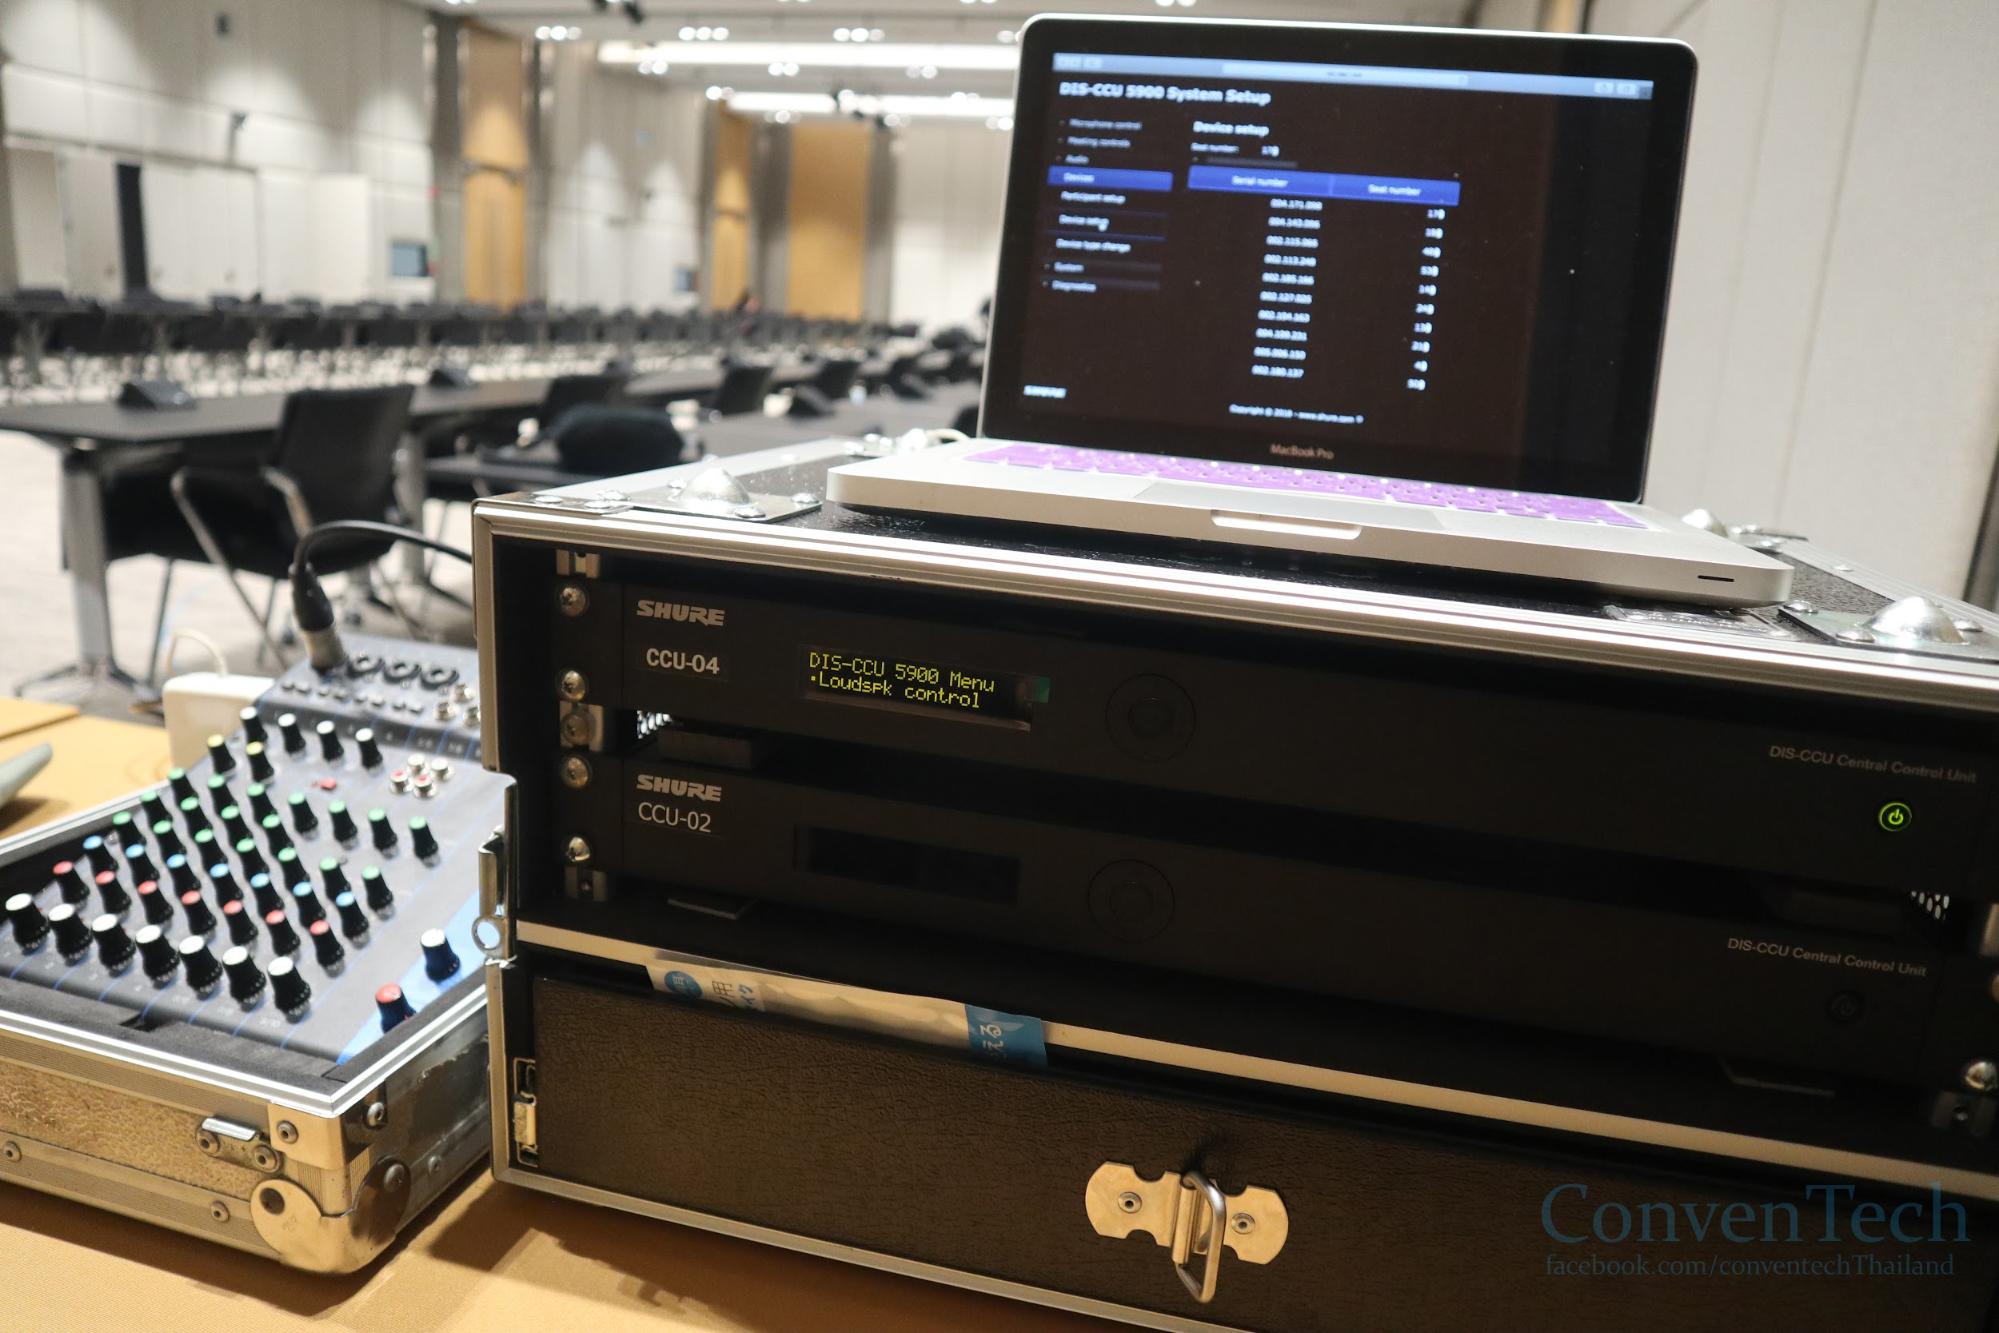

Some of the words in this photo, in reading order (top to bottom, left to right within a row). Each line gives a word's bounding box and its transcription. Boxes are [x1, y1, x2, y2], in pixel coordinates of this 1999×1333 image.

[1059, 81, 1124, 98] DIS-CCU
[1125, 84, 1165, 99] 5900
[1166, 86, 1224, 103] System
[1225, 88, 1271, 106] Setup
[1193, 120, 1233, 135] Device
[1271, 443, 1314, 457] MacBook
[1316, 447, 1335, 460] Pro
[636, 600, 725, 627] SHURE
[646, 647, 720, 675] CCU-04
[809, 651, 886, 677] DIS-CCU
[895, 663, 940, 685] 5900
[949, 671, 995, 692] Menu
[904, 685, 981, 709] control
[1769, 745, 1834, 765] DIS-CCU
[1836, 754, 1888, 773] Central
[1891, 761, 1944, 780] Control
[1947, 768, 1977, 784] Unit
[636, 774, 722, 801] SHURE
[638, 801, 712, 833] CCU-02
[1727, 937, 1790, 957] DIS-CCU
[1792, 947, 1841, 966] Central
[1844, 954, 1895, 973] Control
[1898, 962, 1927, 977] Unit
